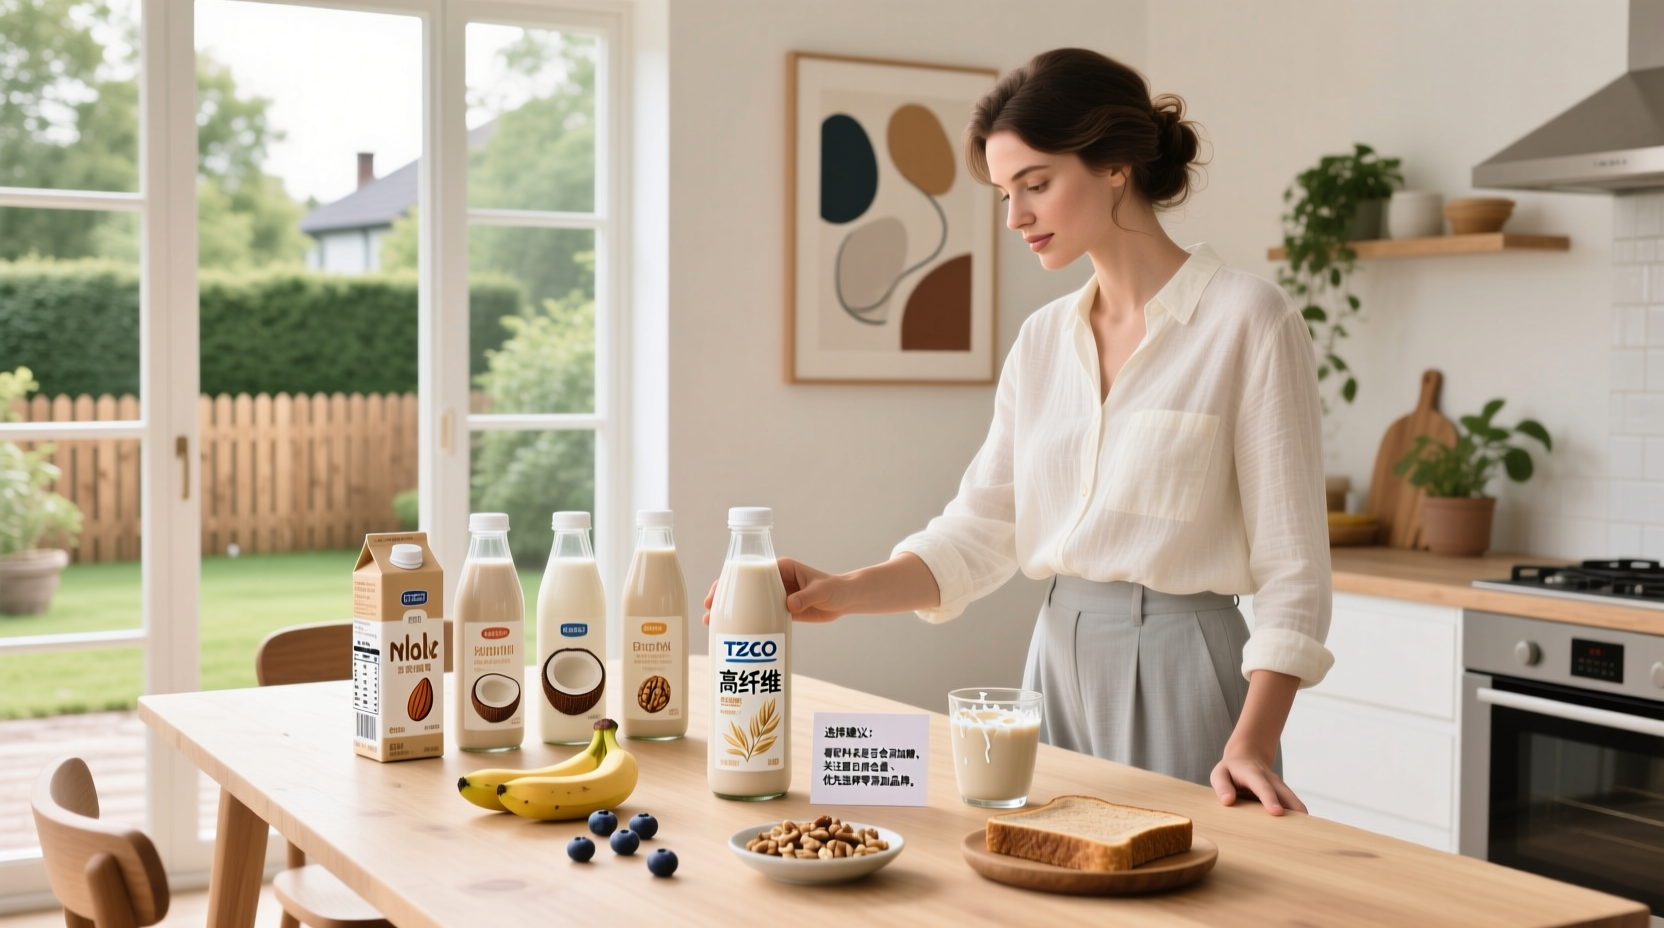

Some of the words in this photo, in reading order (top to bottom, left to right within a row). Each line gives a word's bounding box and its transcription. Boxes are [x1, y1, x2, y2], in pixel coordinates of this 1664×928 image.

[723, 640, 777, 657] TZCO
[719, 669, 782, 695] 高纤维
